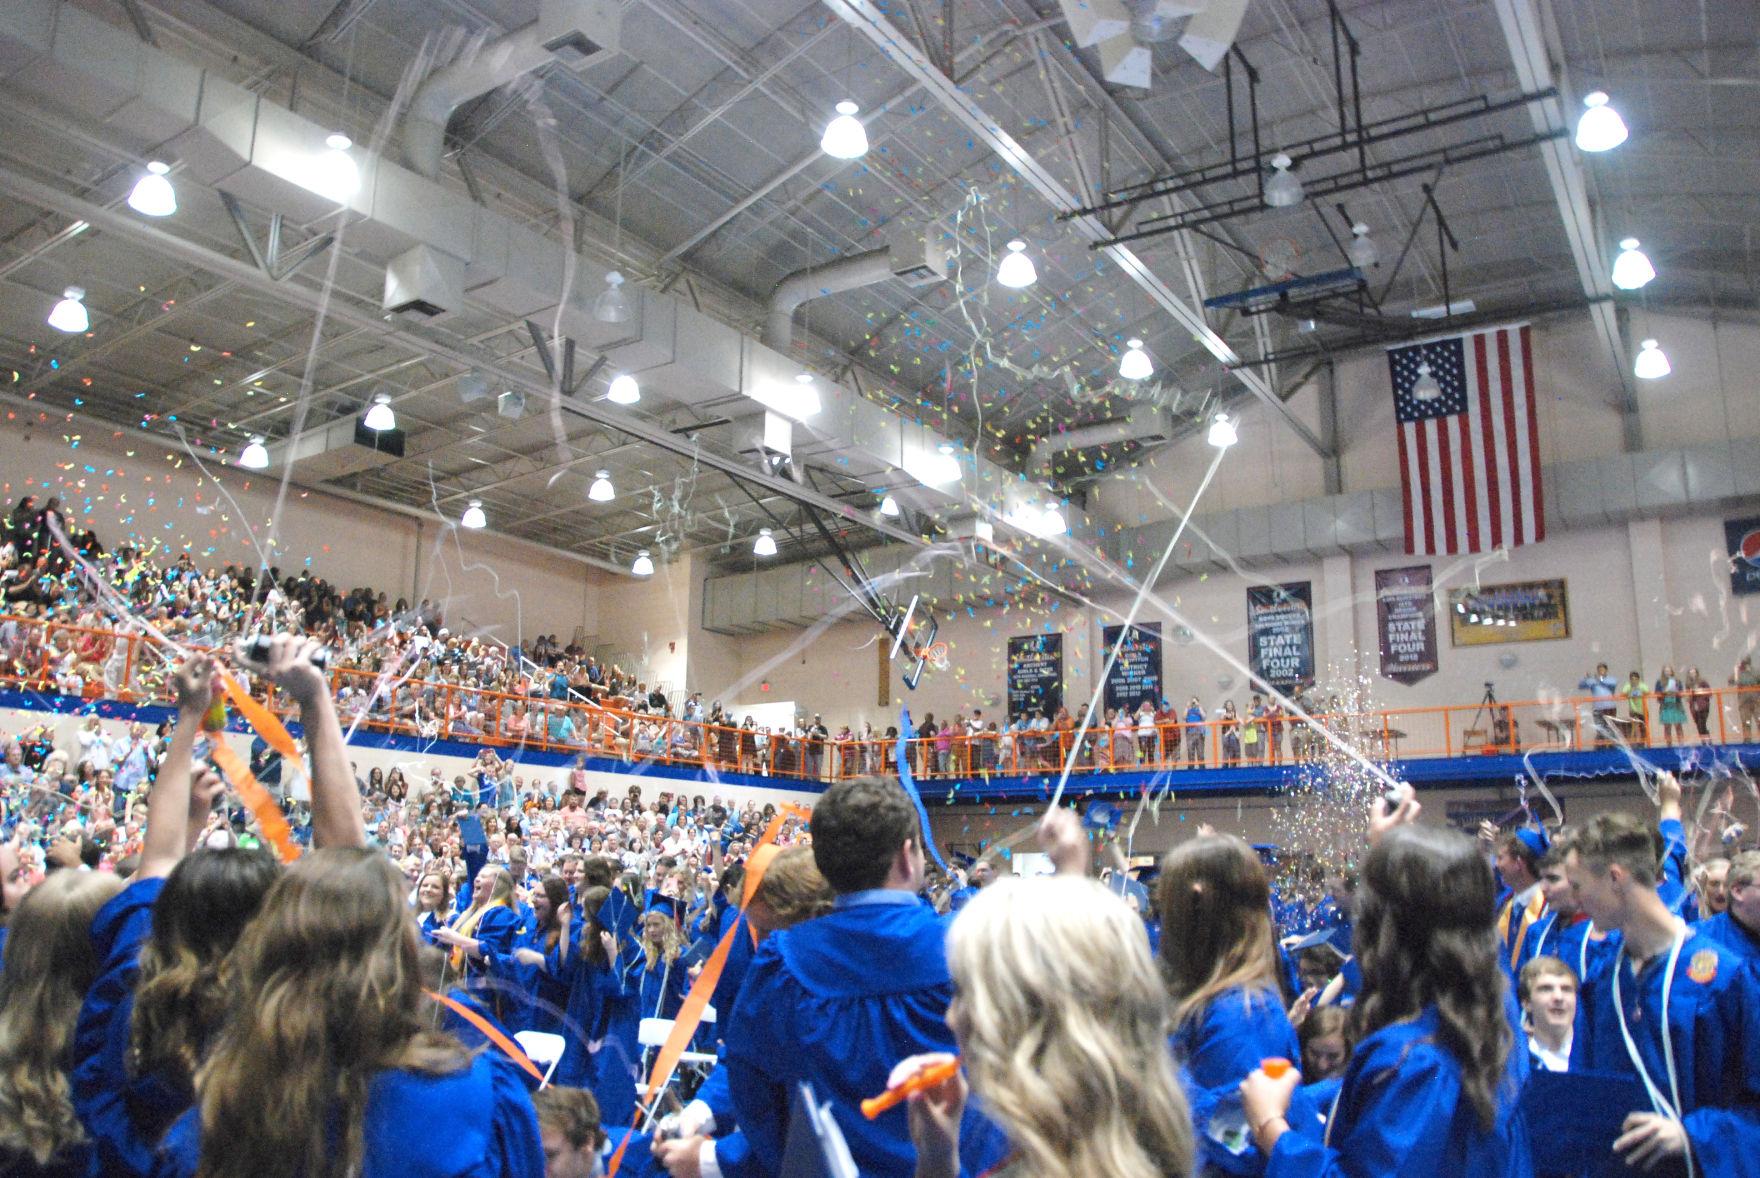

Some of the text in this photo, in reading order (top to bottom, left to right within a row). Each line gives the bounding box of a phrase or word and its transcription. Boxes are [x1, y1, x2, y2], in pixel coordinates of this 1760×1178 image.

[1387, 619, 1426, 632] STATE
[1260, 633, 1302, 647] STATE
[1388, 632, 1426, 643] FINAL
[1261, 645, 1301, 659] FINAL
[1390, 643, 1425, 654] FOUR
[1262, 657, 1300, 670] FOUR
[1269, 669, 1294, 678] 2002
